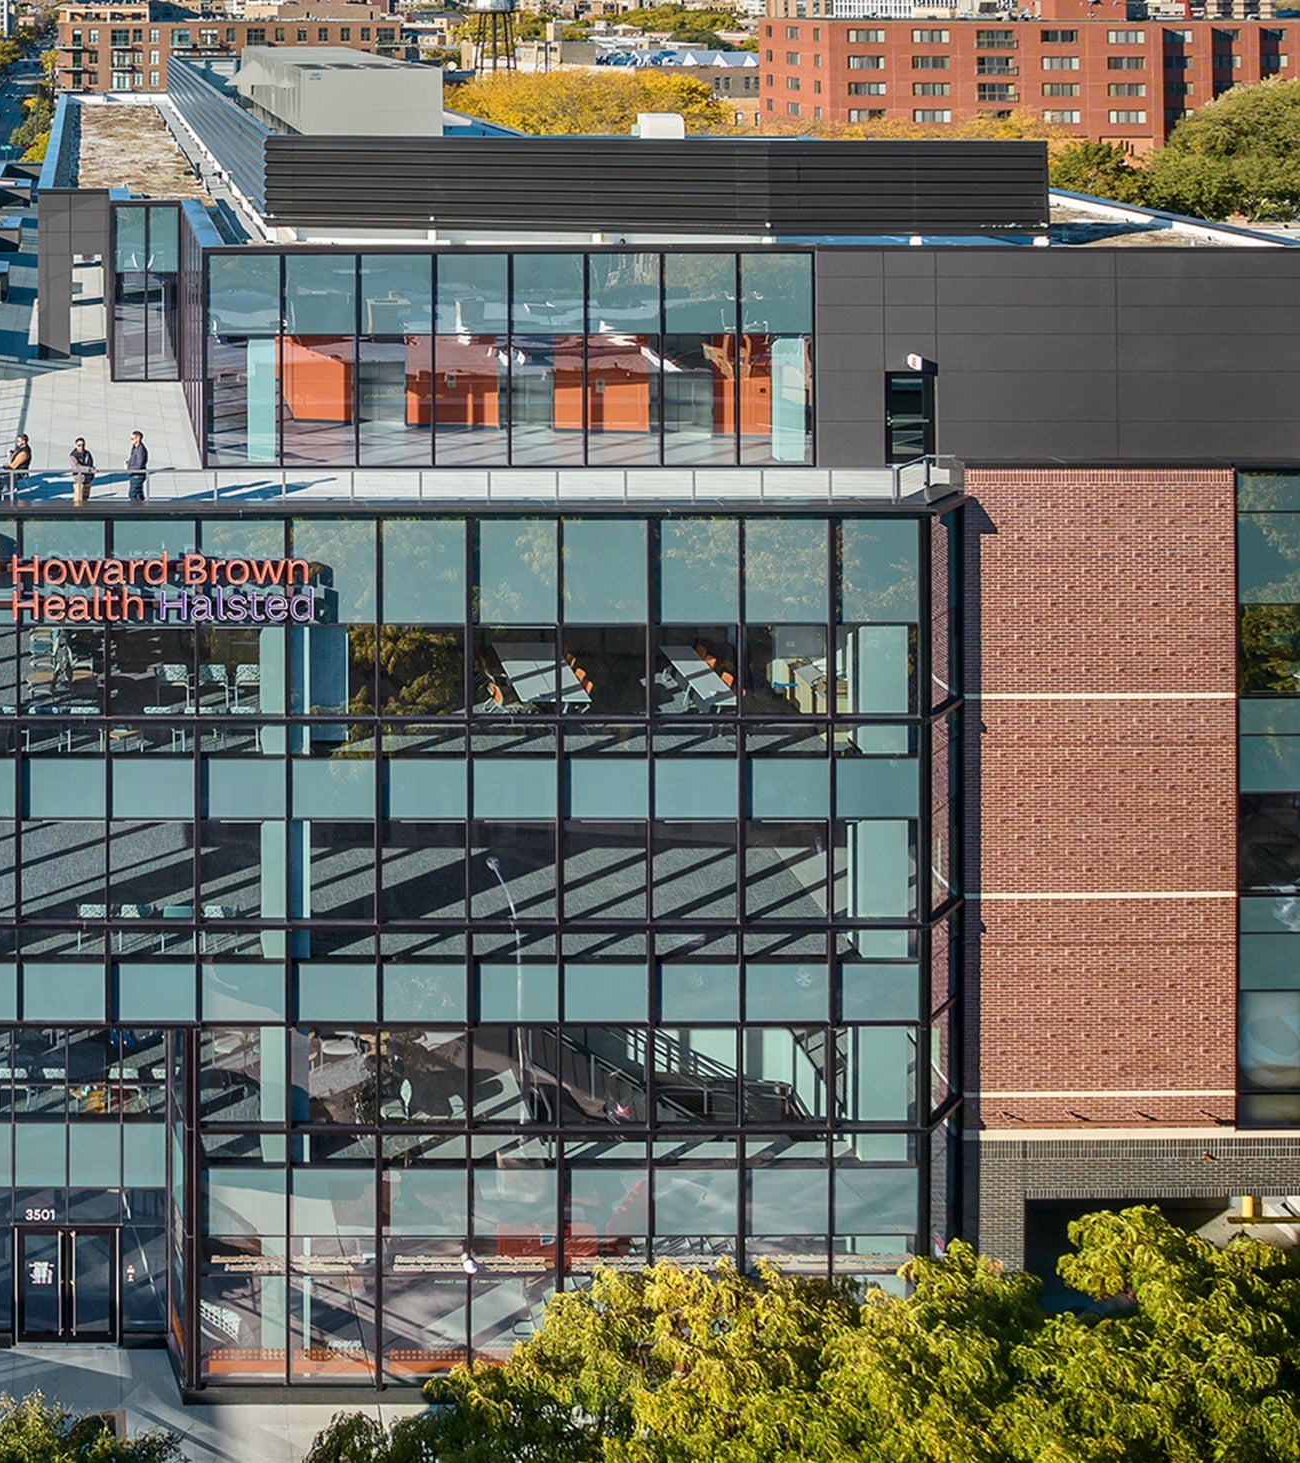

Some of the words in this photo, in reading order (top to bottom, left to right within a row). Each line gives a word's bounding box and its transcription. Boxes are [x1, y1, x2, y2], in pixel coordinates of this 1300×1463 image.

[11, 550, 168, 585] Howard
[184, 554, 309, 585] Brown
[11, 586, 144, 621] Health
[159, 586, 315, 621] Halsted
[25, 1208, 56, 1221] 3501
